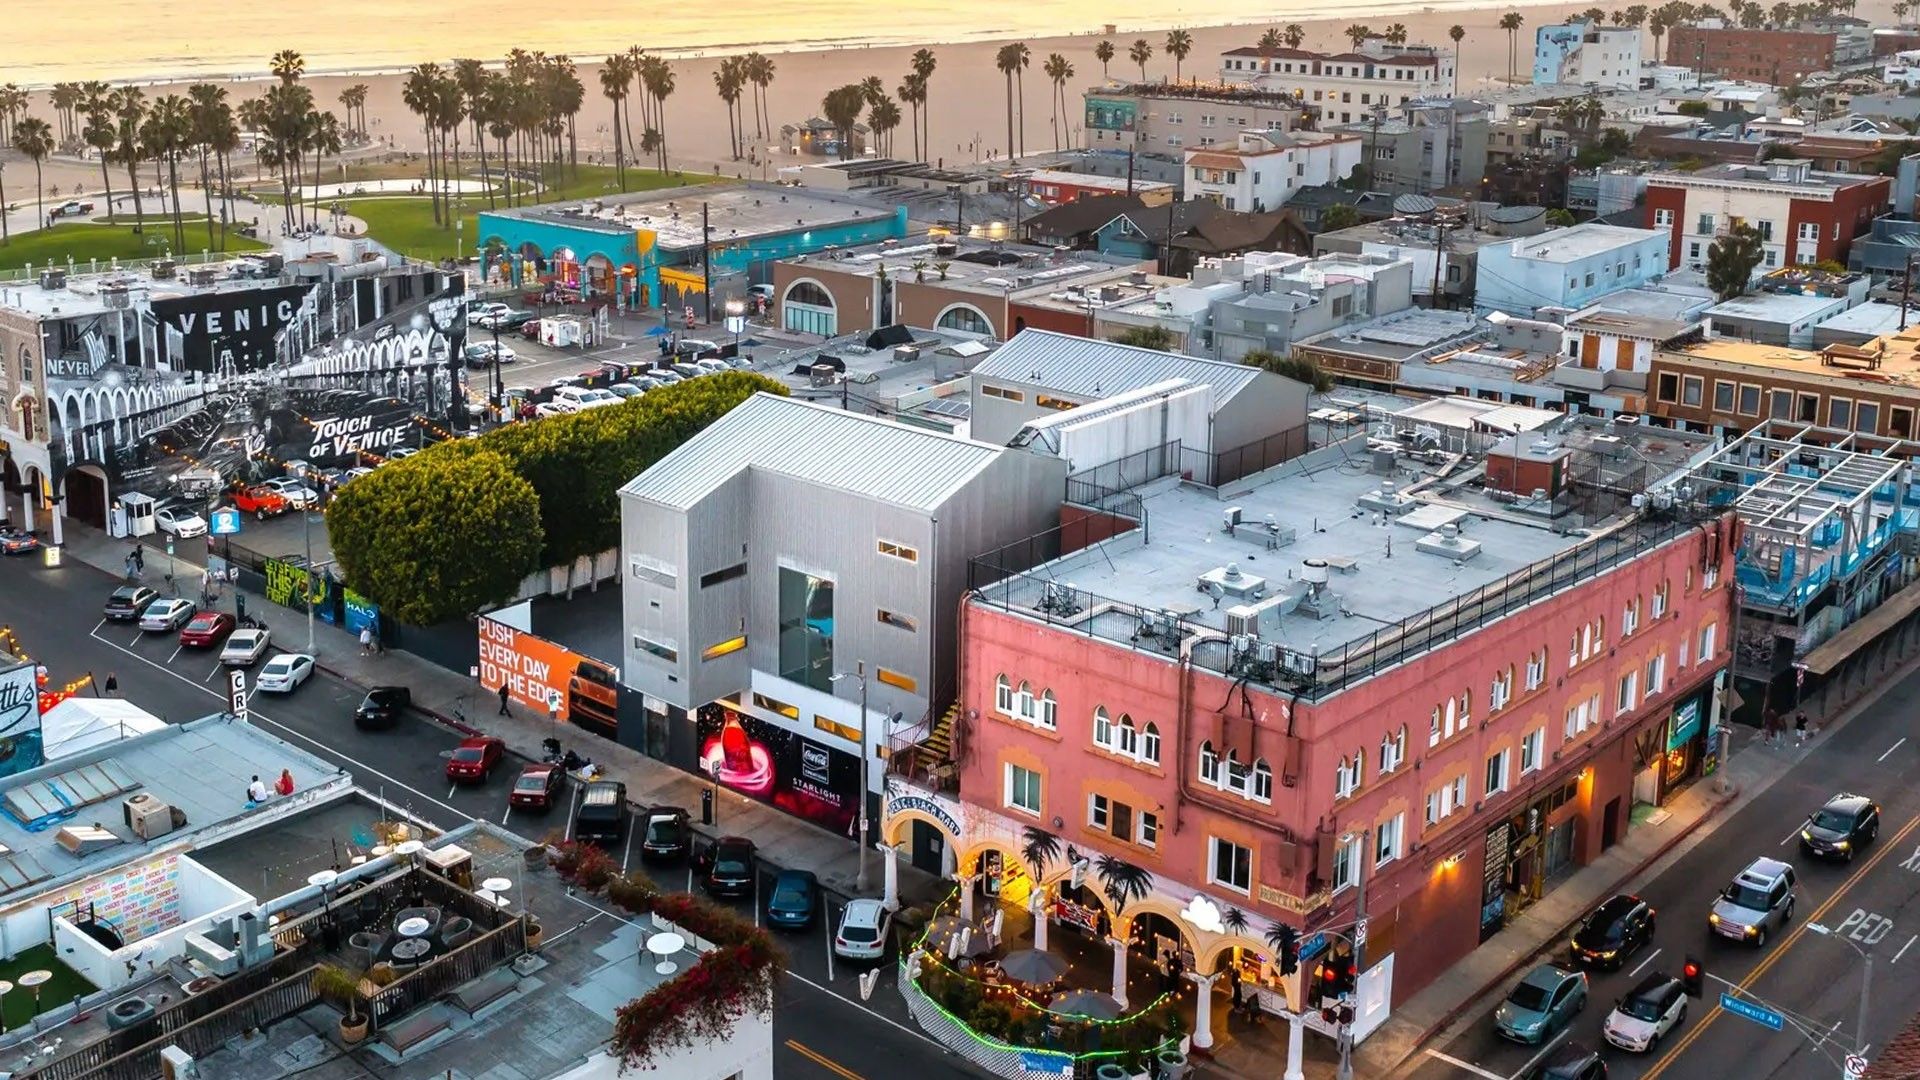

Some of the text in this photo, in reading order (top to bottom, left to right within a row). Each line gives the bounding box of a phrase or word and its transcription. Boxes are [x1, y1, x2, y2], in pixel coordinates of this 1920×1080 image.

[309, 422, 413, 458] OF VENICE
[310, 415, 373, 444] TOUCH
[347, 602, 376, 619] HALO
[479, 616, 514, 647] PUSH
[480, 638, 550, 682] EVERY DAY
[480, 660, 497, 682] TO
[499, 668, 526, 696] THE
[793, 777, 840, 802] STARLIGHT
[938, 810, 960, 835] MART
[1835, 907, 1893, 944] PED
[1724, 998, 1778, 1025] Windward Av
